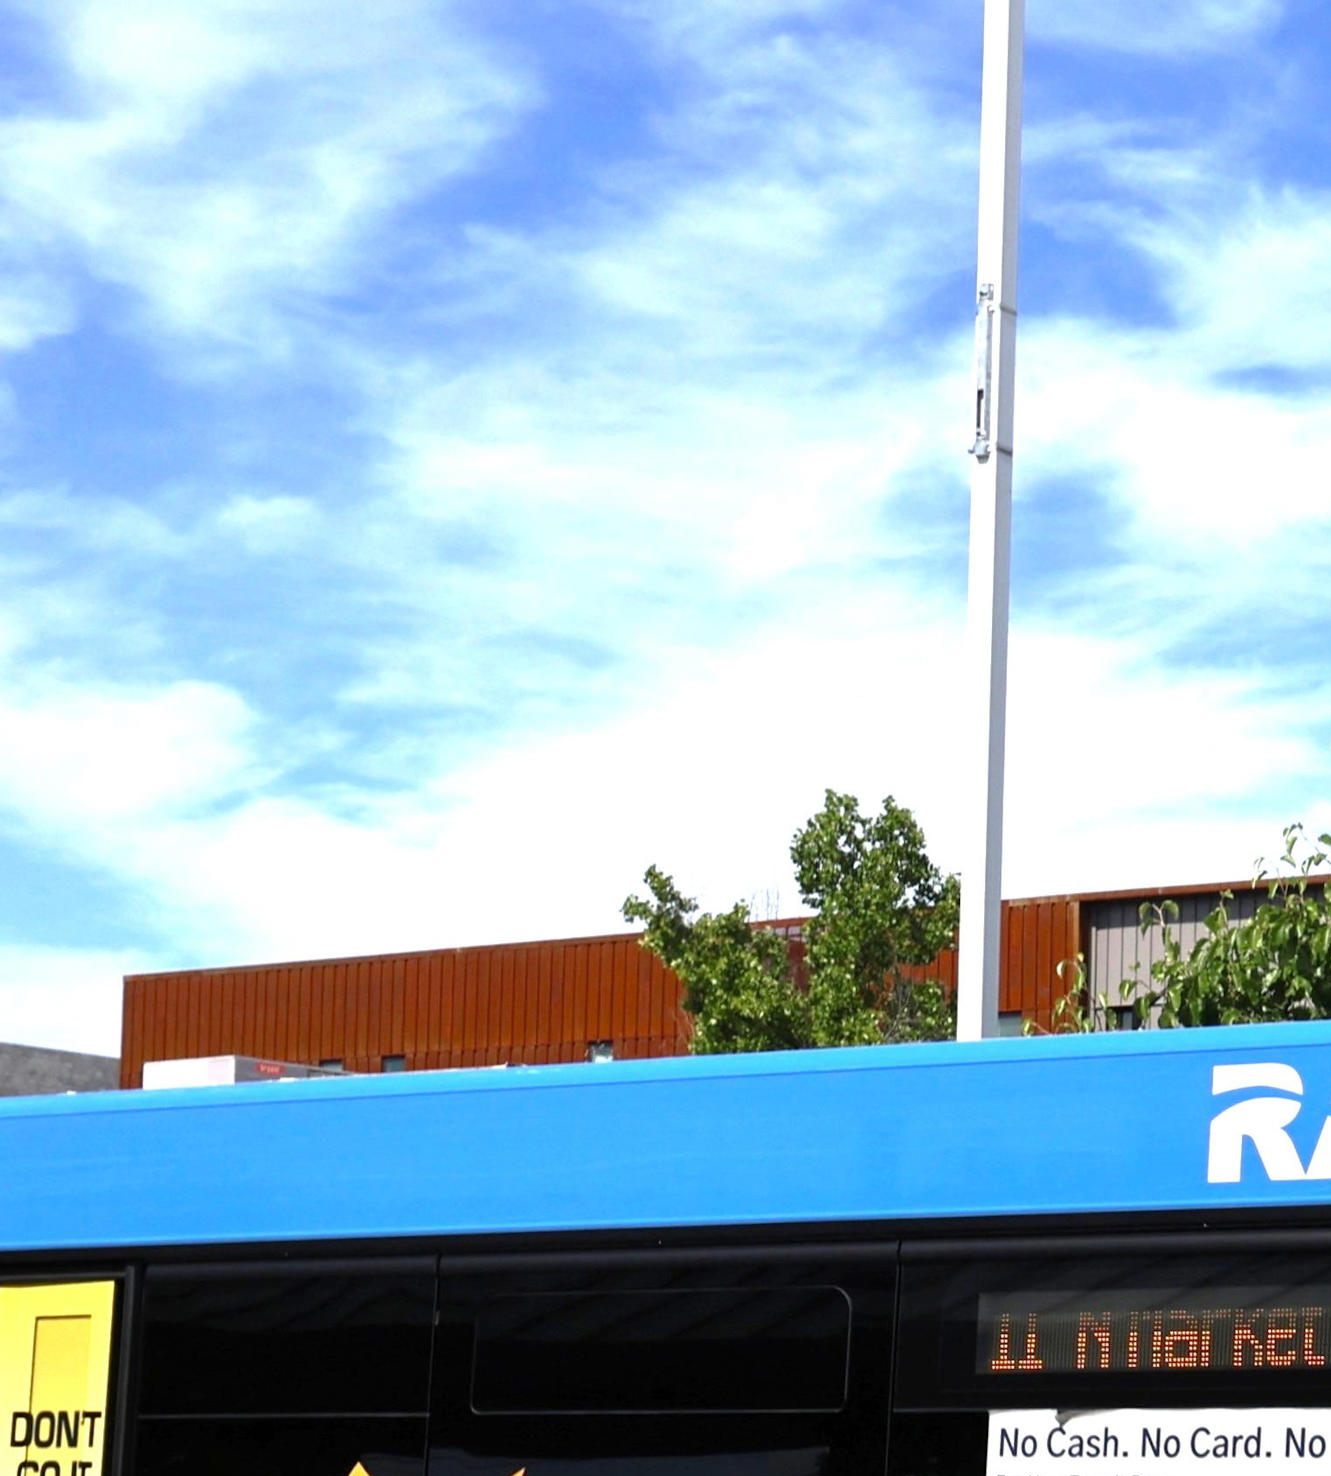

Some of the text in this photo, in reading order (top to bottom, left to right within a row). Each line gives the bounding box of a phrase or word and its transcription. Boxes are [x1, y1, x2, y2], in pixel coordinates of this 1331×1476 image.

[11, 1410, 102, 1449] DON'T
[999, 1427, 1038, 1458] No
[1046, 1426, 1129, 1458] Cash.
[1141, 1427, 1181, 1458] No
[1190, 1426, 1272, 1459] Card.
[1285, 1427, 1327, 1459] No
